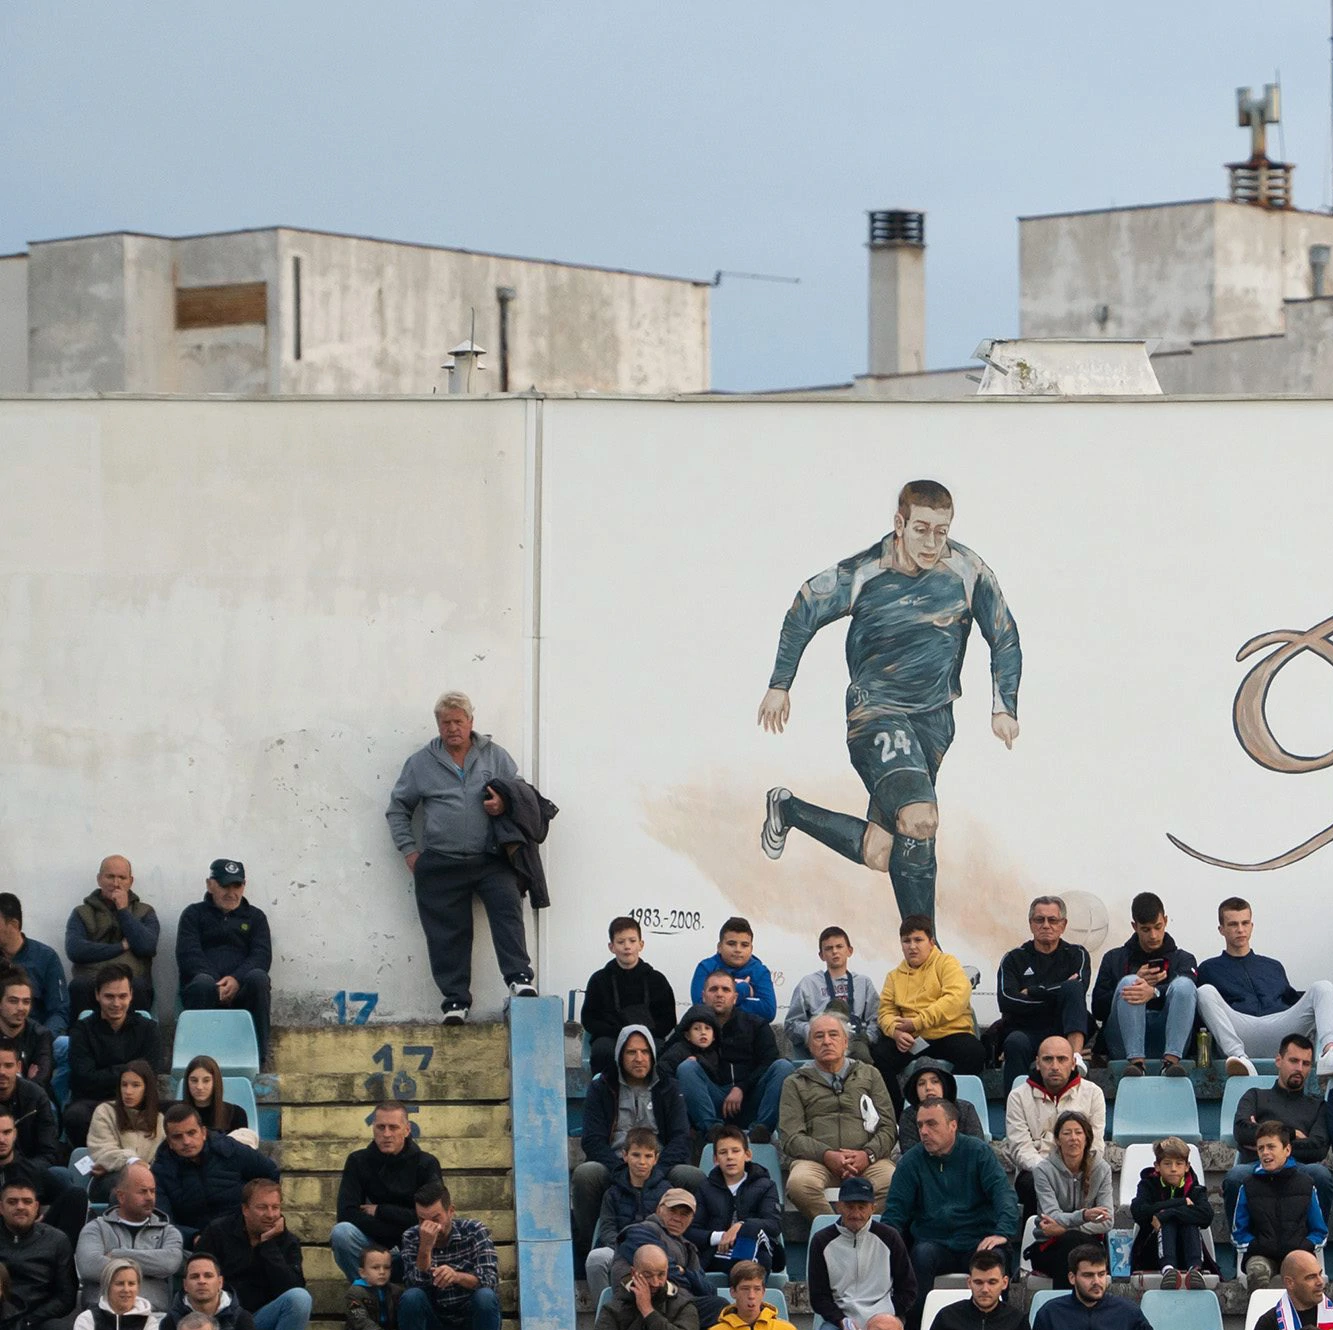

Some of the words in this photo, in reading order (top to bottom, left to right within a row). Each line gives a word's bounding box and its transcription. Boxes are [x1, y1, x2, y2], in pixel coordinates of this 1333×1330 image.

[874, 729, 911, 762] 24
[331, 991, 379, 1025] 17
[373, 1045, 434, 1072] 17
